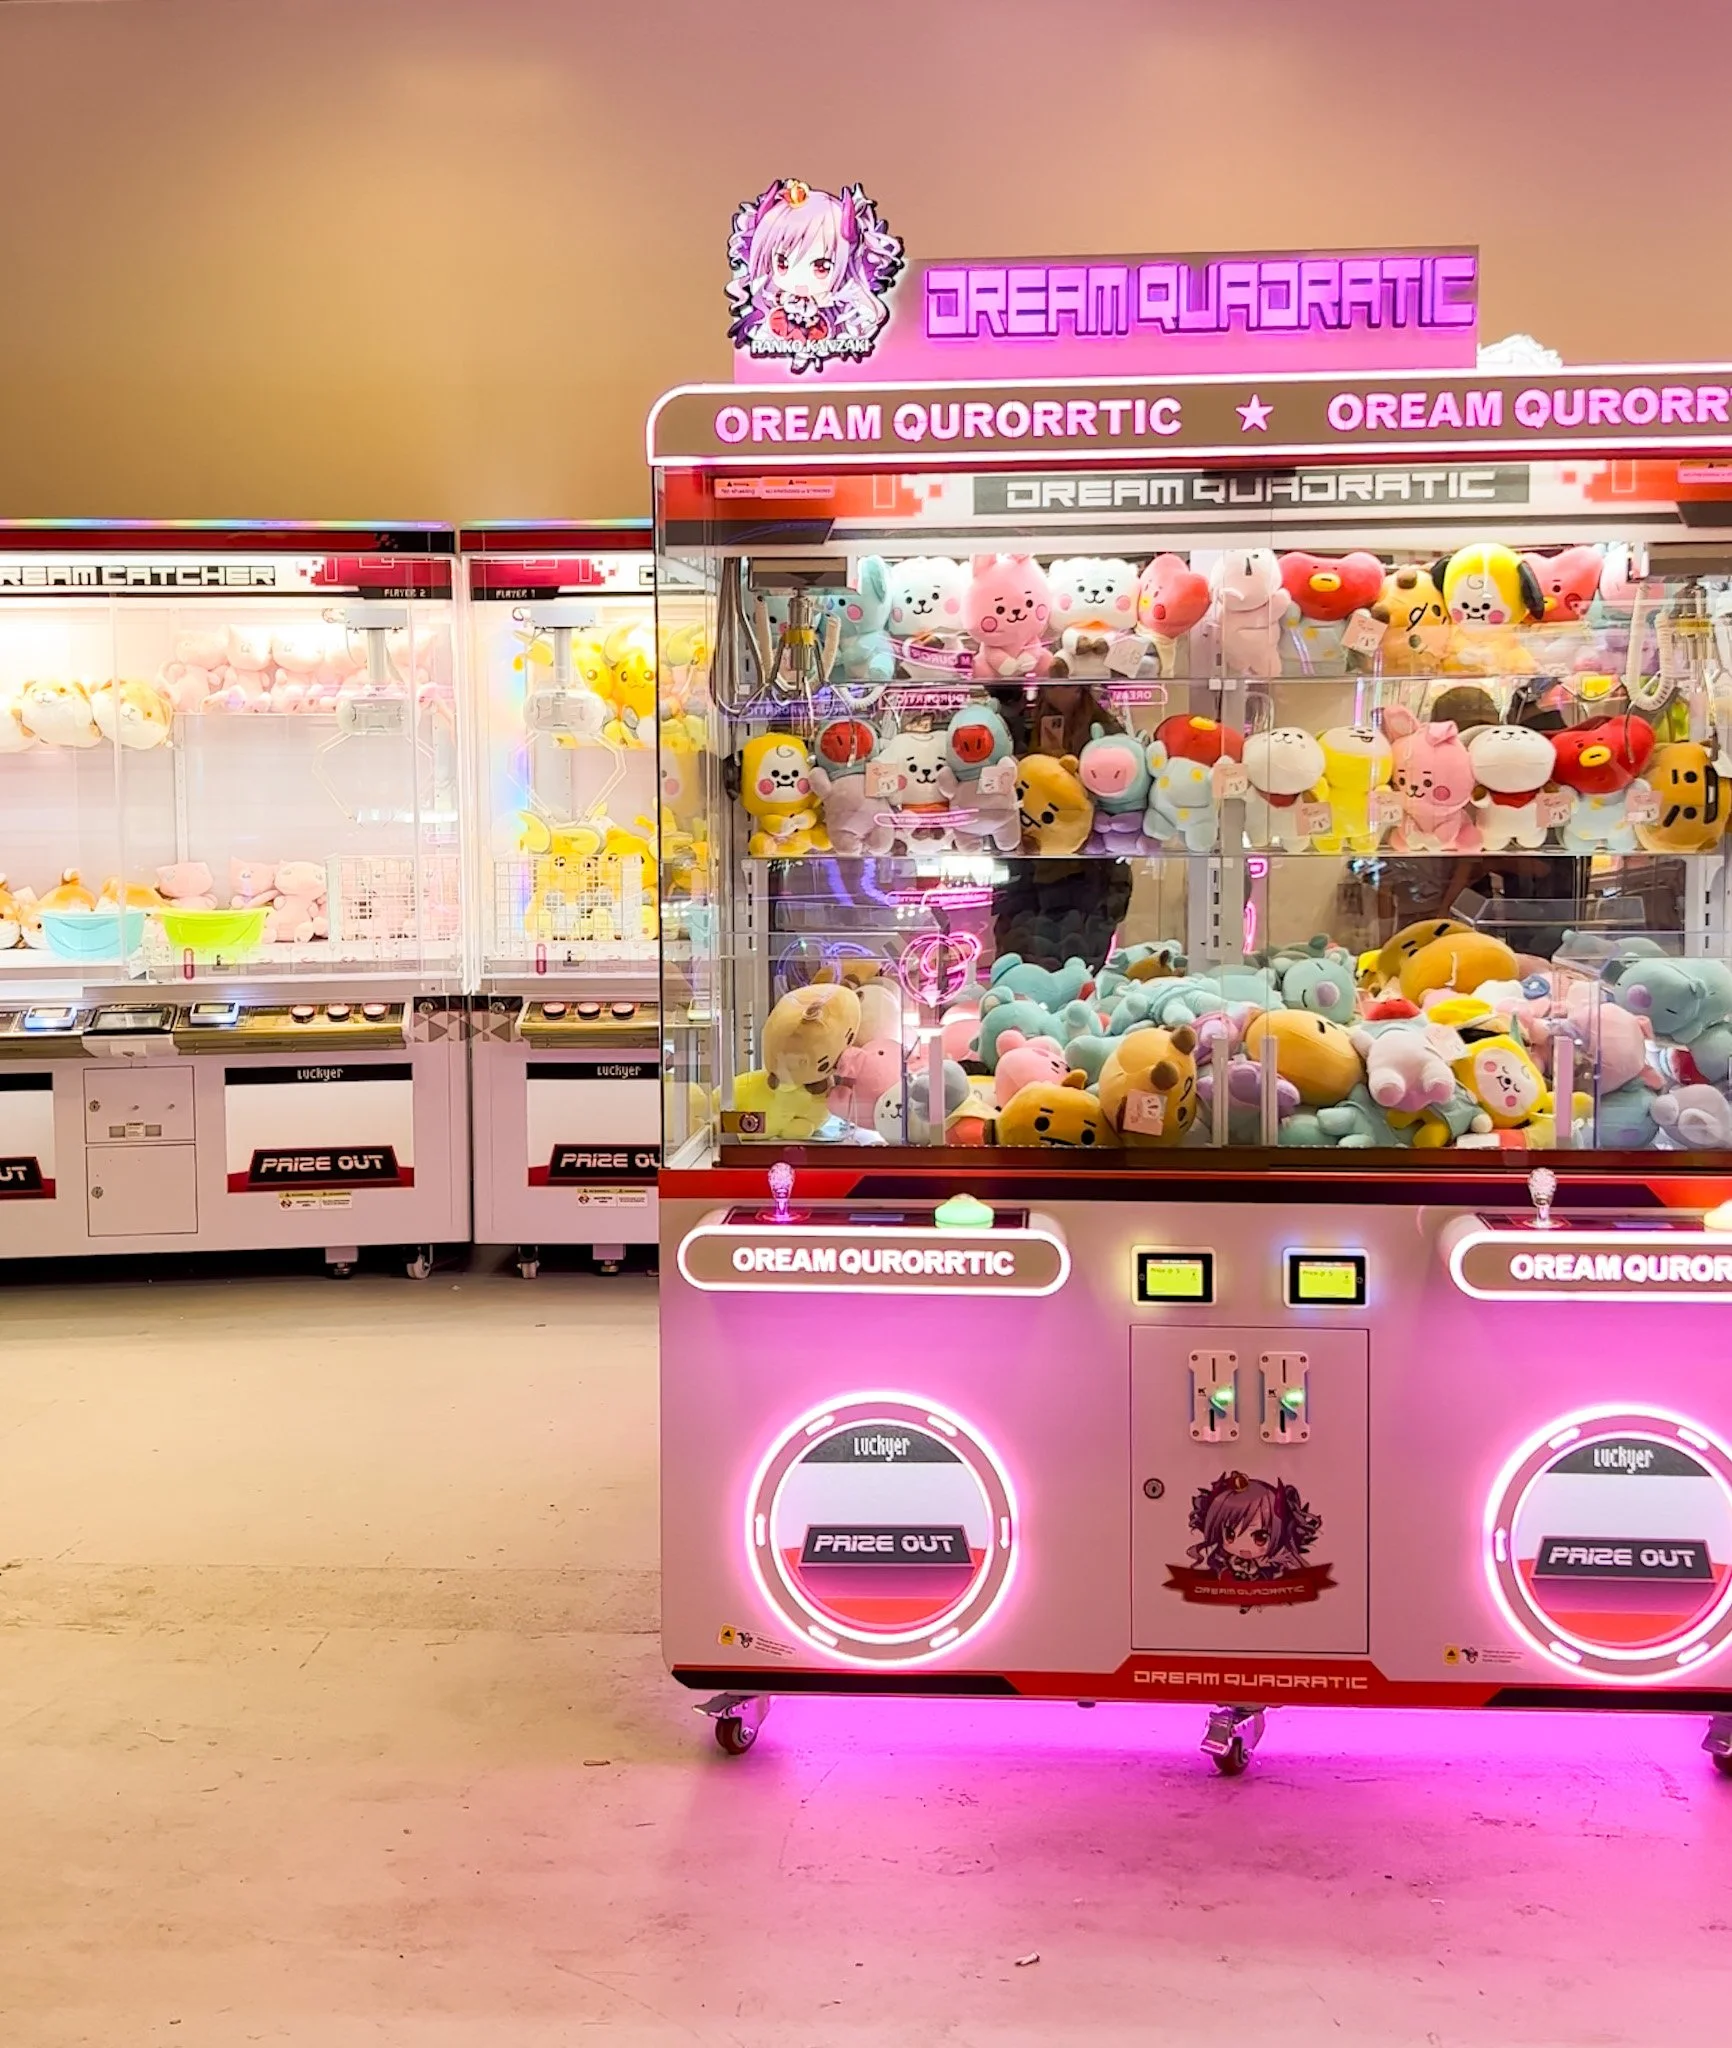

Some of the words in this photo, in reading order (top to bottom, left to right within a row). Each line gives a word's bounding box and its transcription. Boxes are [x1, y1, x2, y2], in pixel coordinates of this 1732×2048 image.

[926, 267, 1129, 338] DREAM
[1136, 256, 1476, 333] QUADRATIC
[1327, 390, 1503, 431] OREAM
[1514, 385, 1732, 429] QURORR
[715, 404, 883, 443] OREAM
[1006, 478, 1184, 508] DREAM
[1193, 471, 1496, 504] QUADRATIC
[100, 565, 276, 586] CATCHER
[384, 589, 416, 598] PLAYER
[419, 589, 426, 597] 2
[495, 590, 527, 599] PLAYER
[260, 1156, 331, 1173] PRIZE
[337, 1154, 384, 1170] OUT
[560, 1153, 628, 1168] PRIZE
[732, 1247, 836, 1273] OREAM
[1509, 1253, 1622, 1281] OREAM
[814, 1534, 894, 1552] PRIZE
[901, 1535, 954, 1552] OUT
[1549, 1546, 1632, 1566] PRIZE
[1640, 1549, 1695, 1568] OUT
[1133, 1670, 1220, 1686] DREAM
[1223, 1673, 1368, 1690] QUADRATIC
